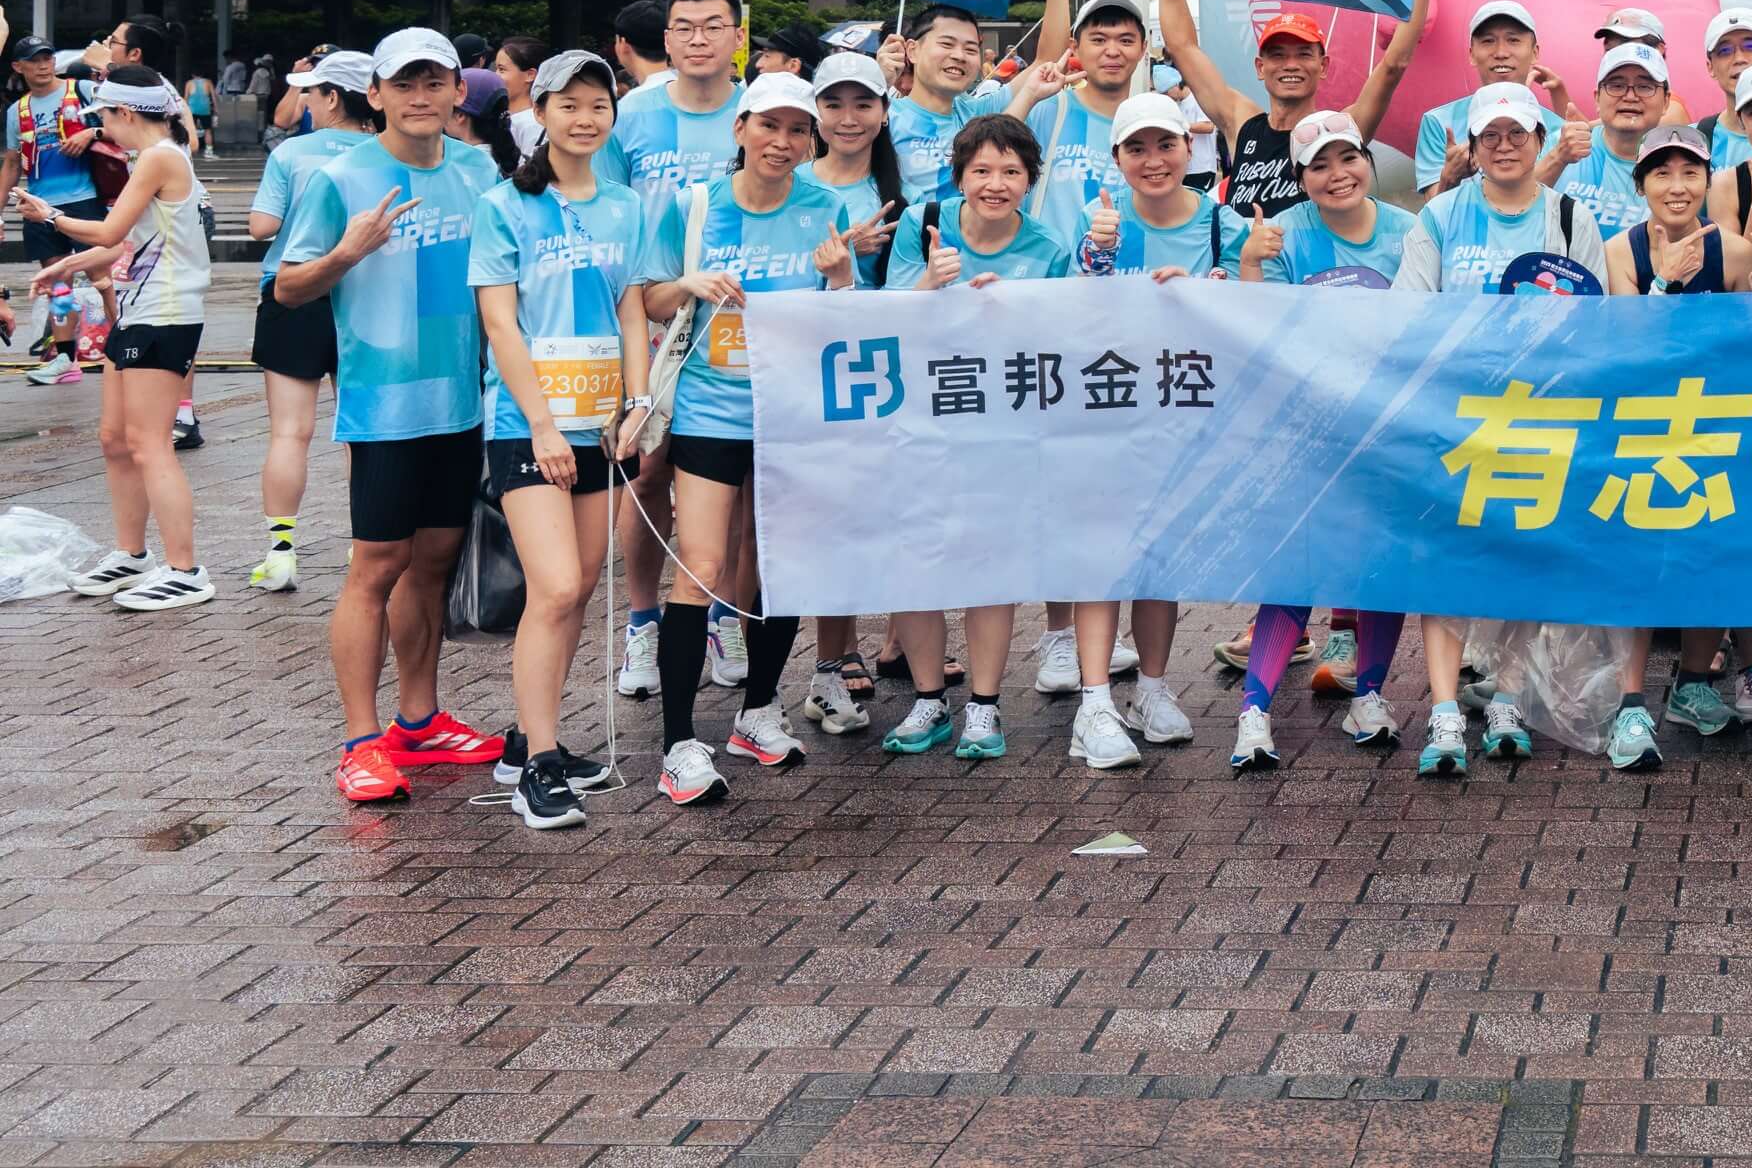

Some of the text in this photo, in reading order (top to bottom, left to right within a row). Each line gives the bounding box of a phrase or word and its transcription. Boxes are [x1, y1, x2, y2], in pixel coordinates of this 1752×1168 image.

[640, 148, 712, 172] RUN FOR
[1055, 143, 1089, 160] RUN
[1234, 158, 1289, 183] FUBON
[1230, 183, 1263, 210] RUN
[1565, 181, 1600, 200] RUN
[419, 207, 440, 219] FOR
[705, 244, 746, 262] RUN
[1452, 244, 1515, 261] RUN FOR
[124, 347, 139, 360] T8
[538, 371, 620, 395] 230317
[926, 347, 1217, 418] 富邦金控
